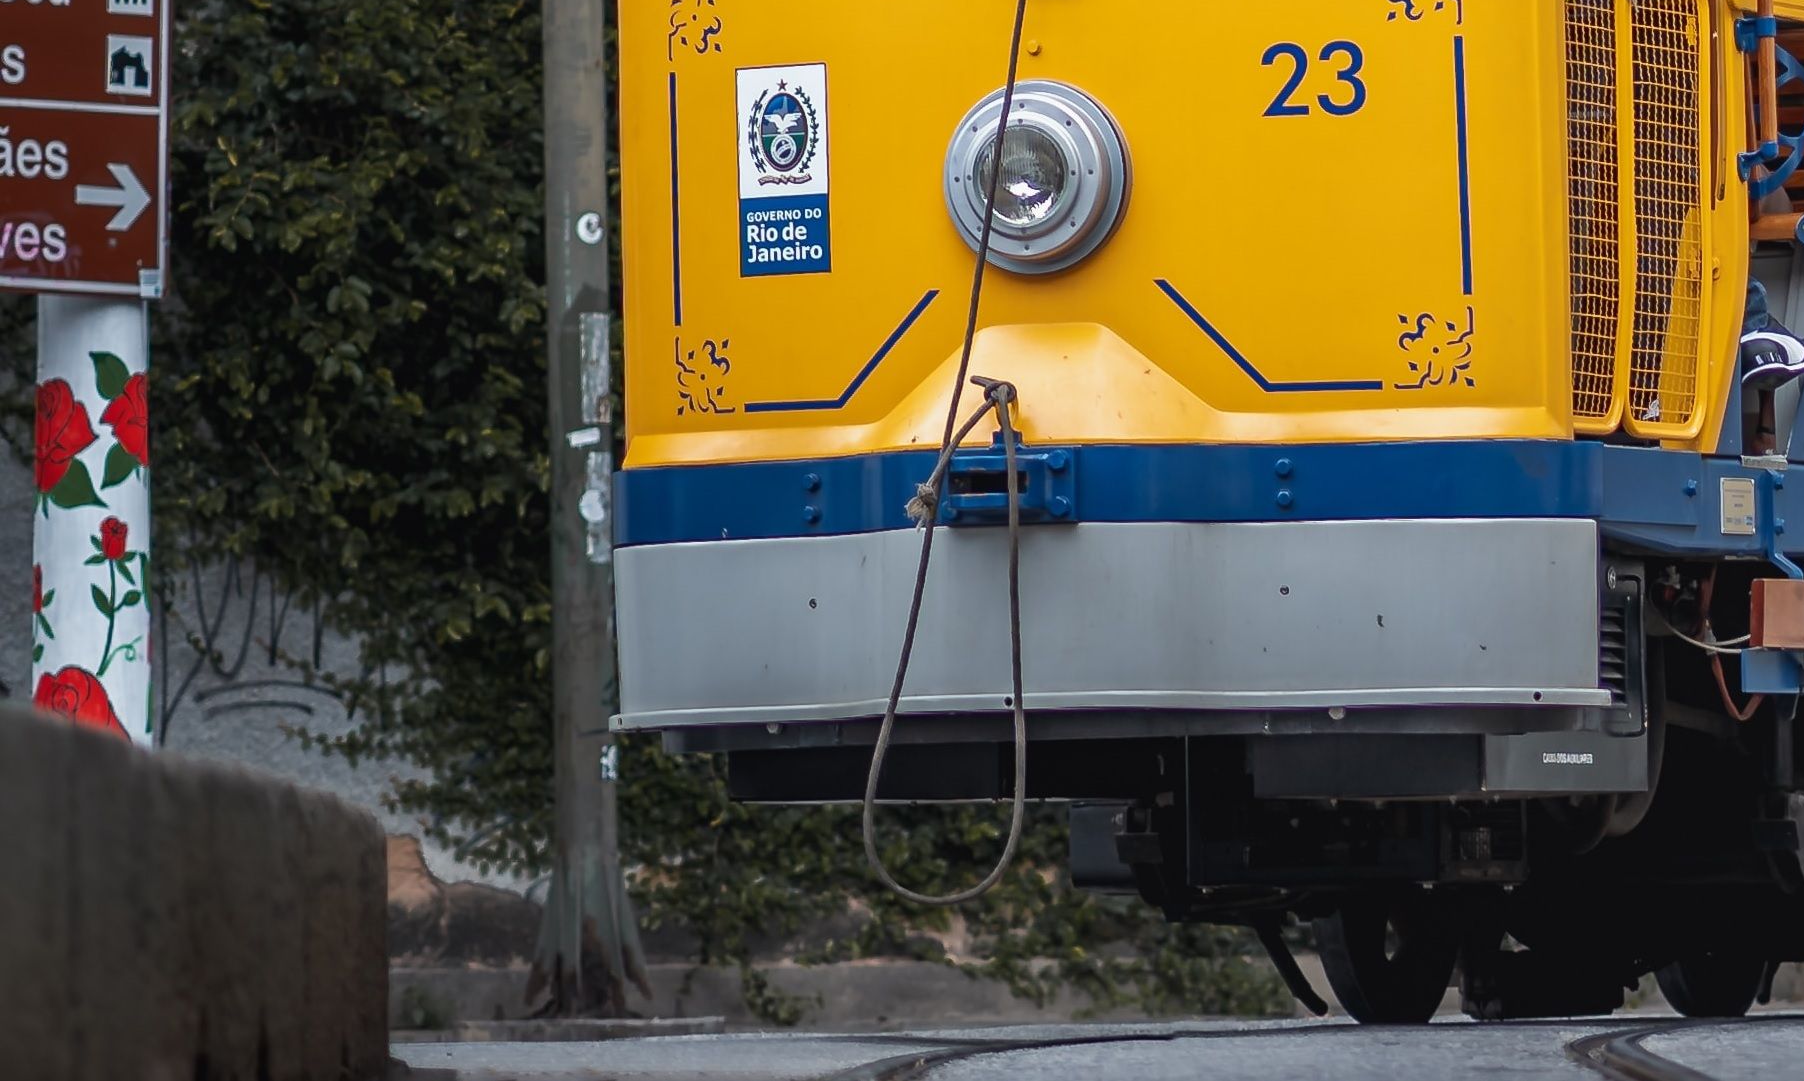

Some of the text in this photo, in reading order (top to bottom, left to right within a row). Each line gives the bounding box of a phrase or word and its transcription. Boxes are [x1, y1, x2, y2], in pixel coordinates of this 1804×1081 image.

[1261, 40, 1366, 117] 23
[746, 207, 822, 223] GOVERNO DO
[747, 221, 807, 243] Rio de
[747, 241, 823, 263] Janeiro
